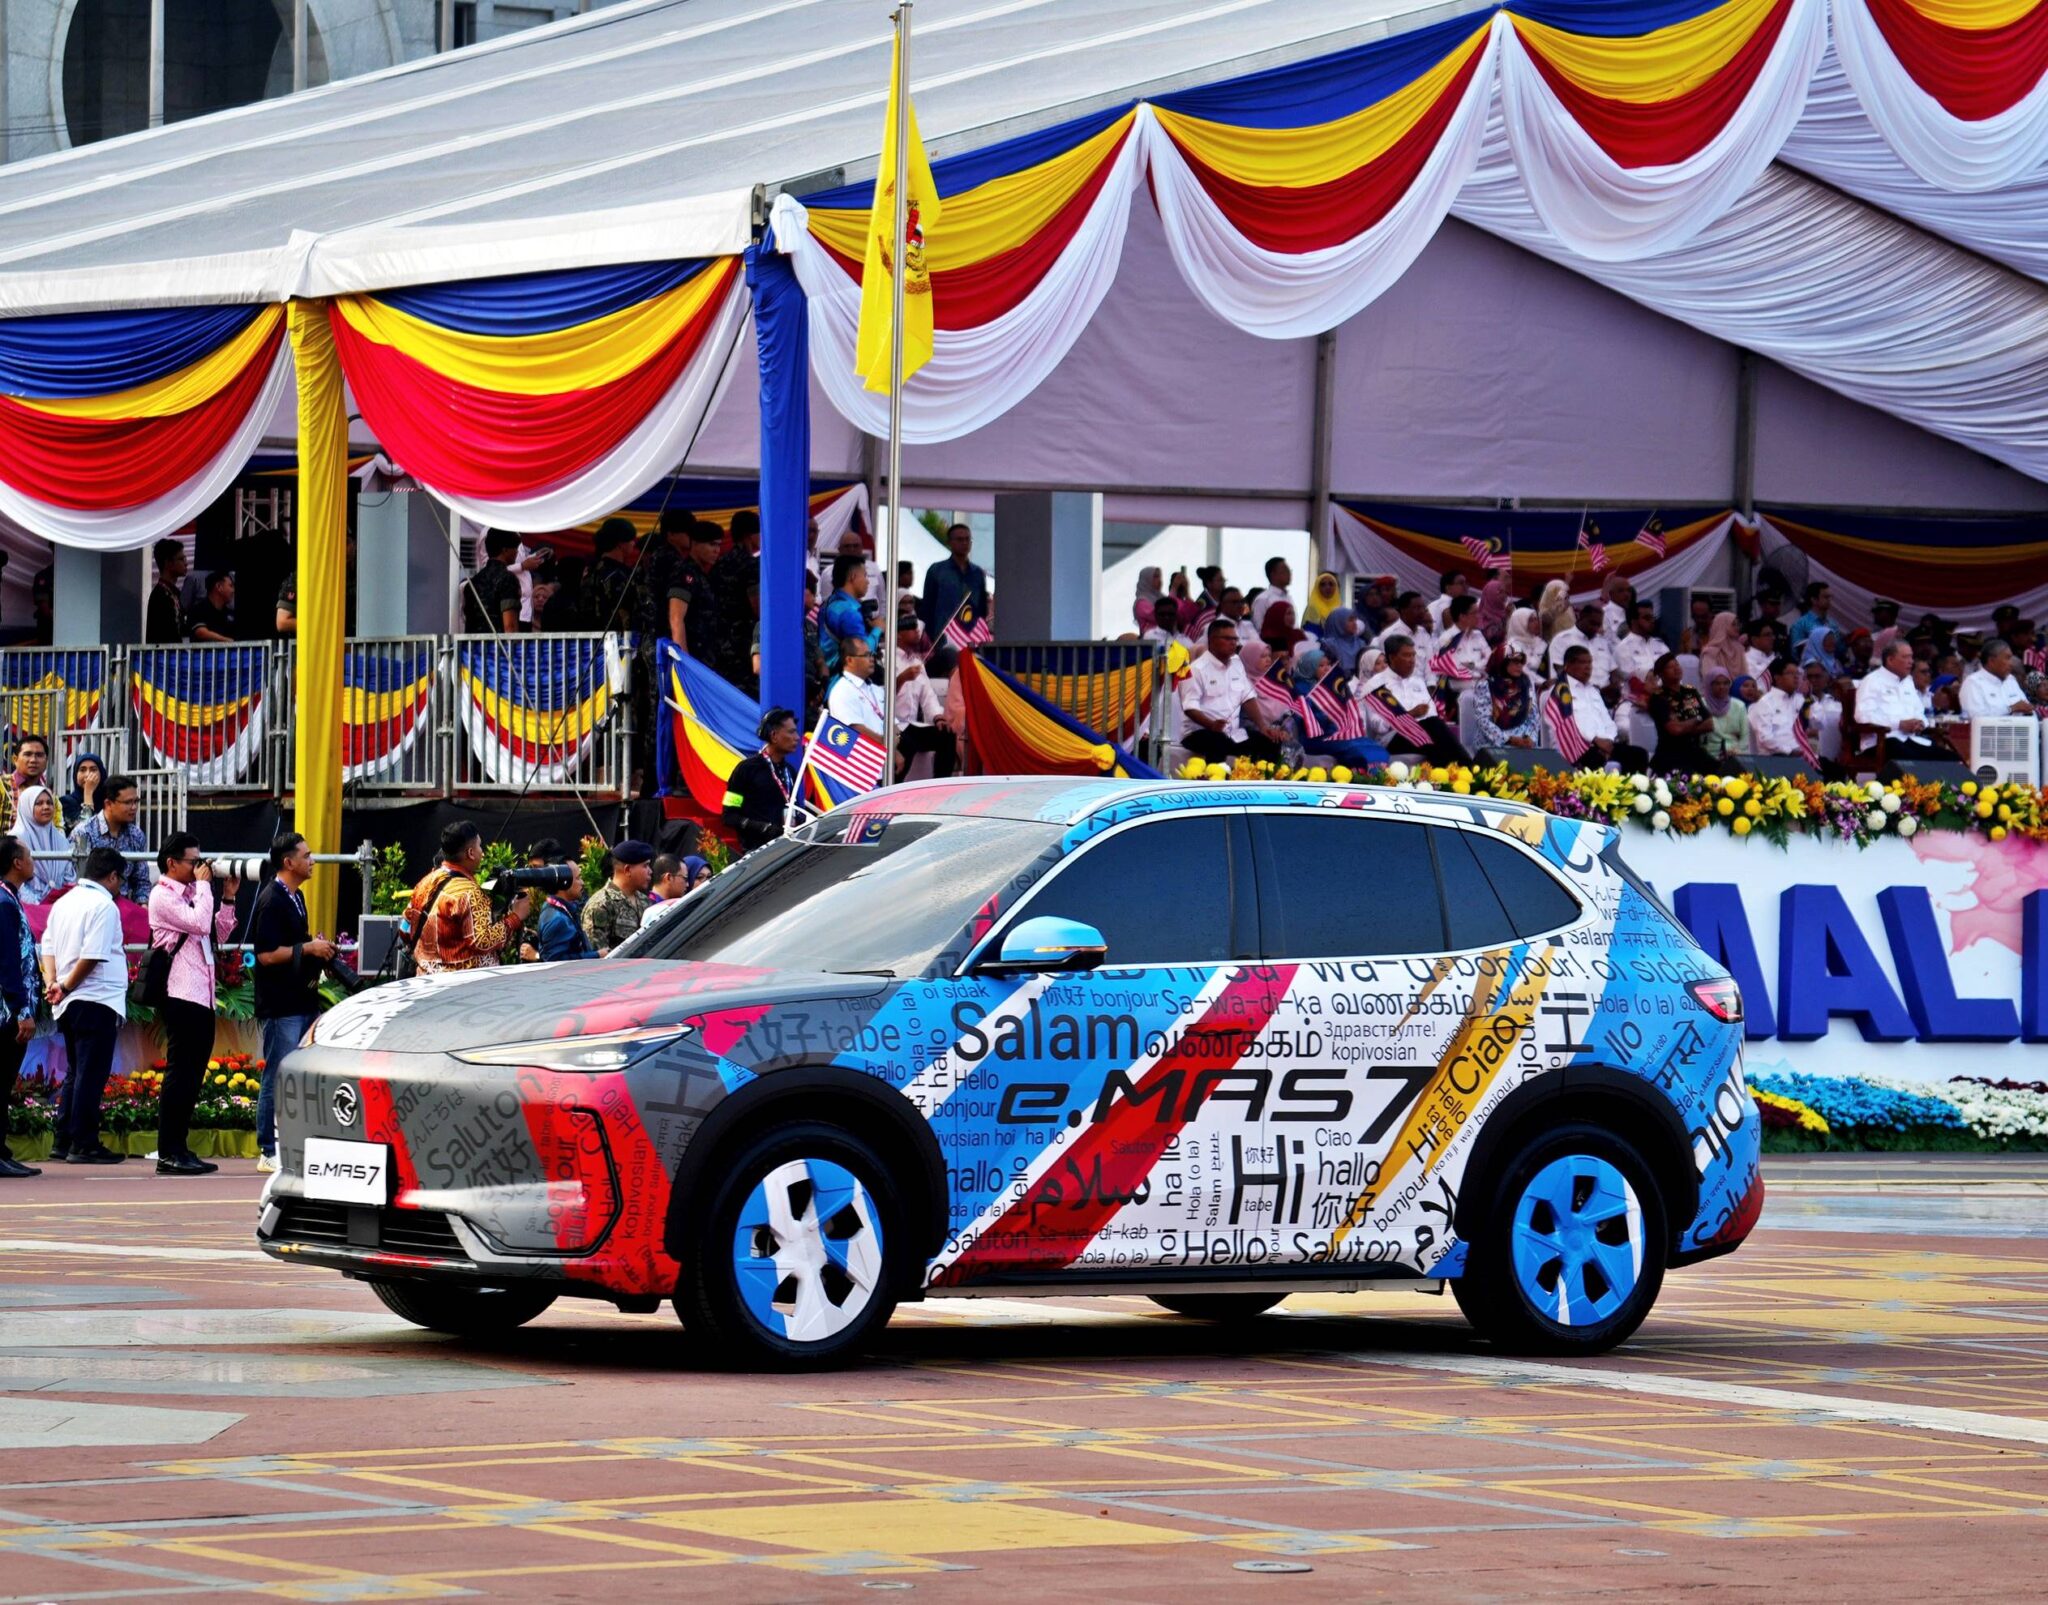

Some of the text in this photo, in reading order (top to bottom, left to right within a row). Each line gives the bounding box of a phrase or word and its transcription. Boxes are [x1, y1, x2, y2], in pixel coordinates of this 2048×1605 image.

[1569, 928, 1617, 947] Salam
[1592, 951, 1713, 984] oi sidak
[944, 985, 990, 999] sidak
[1042, 985, 1086, 1007] 你好
[1090, 988, 1159, 1013] bonjour
[1162, 989, 1322, 1016] Sa-wa-di-ka
[1331, 984, 1476, 1016] வணக்கம்
[1591, 992, 1630, 1015] Hola
[820, 1015, 901, 1053] tabe
[951, 997, 1140, 1062] Salam
[865, 1060, 906, 1081] hallo
[911, 1044, 926, 1087] Hola
[927, 1028, 948, 1088] hallo
[1331, 1042, 1417, 1065] kopivosian
[1448, 1014, 1519, 1096] Ciao
[955, 1069, 999, 1091] Hello
[601, 1088, 641, 1138] Hello
[933, 1098, 998, 1123] bonjour
[997, 1067, 1439, 1144] e.MAS7
[1433, 1079, 1468, 1126] Hello
[427, 1074, 545, 1189] Saluton
[1315, 1127, 1353, 1147] Ciao
[1425, 1103, 1455, 1141] tabe
[1245, 1146, 1275, 1165] 你好
[1406, 1122, 1441, 1165] Hi
[308, 1162, 381, 1186] e.MAS7
[1008, 1156, 1029, 1216] Hello
[1228, 1134, 1305, 1225] Hi
[1318, 1151, 1381, 1187] hallo
[622, 1138, 648, 1240] kopivosian
[1186, 1185, 1201, 1221] Hola
[1205, 1179, 1222, 1227] Salam
[1244, 1197, 1273, 1212] tabe
[1373, 1170, 1430, 1233] bonjour
[1312, 1191, 1377, 1230] 你好
[946, 1226, 1029, 1254] Saluton
[1180, 1228, 1268, 1266] Hello
[1289, 1231, 1404, 1265] Saluton
